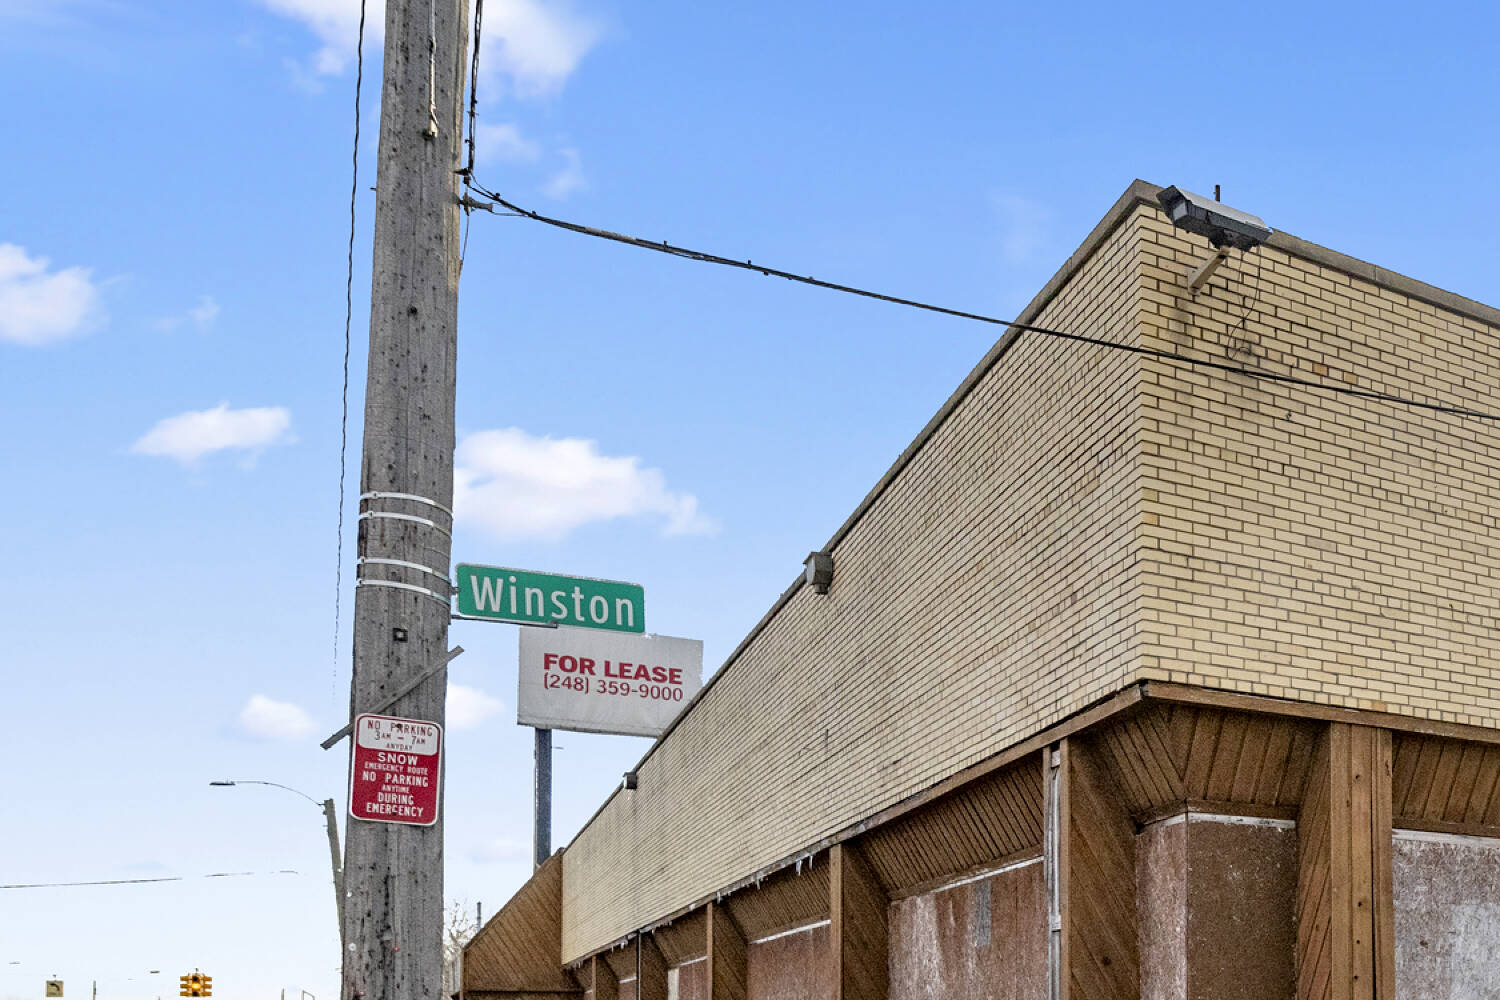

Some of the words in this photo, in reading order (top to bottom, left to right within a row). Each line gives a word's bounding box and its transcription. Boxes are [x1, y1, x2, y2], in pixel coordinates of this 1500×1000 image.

[470, 574, 635, 628] Winston
[543, 652, 596, 676] FOR
[604, 660, 684, 685] LEASE
[543, 672, 590, 695] (248)
[596, 679, 684, 702] 359-9000
[368, 720, 380, 730] NO
[390, 722, 433, 737] PARKING
[377, 751, 418, 767] SNOW
[364, 761, 404, 773] EMERGENCY
[407, 766, 428, 776] ROUTE
[362, 770, 377, 782] NO
[385, 772, 429, 788] PARKING
[382, 784, 410, 794] ANYTIME
[377, 791, 415, 806] DURING
[366, 802, 424, 817] EMERGENCY
